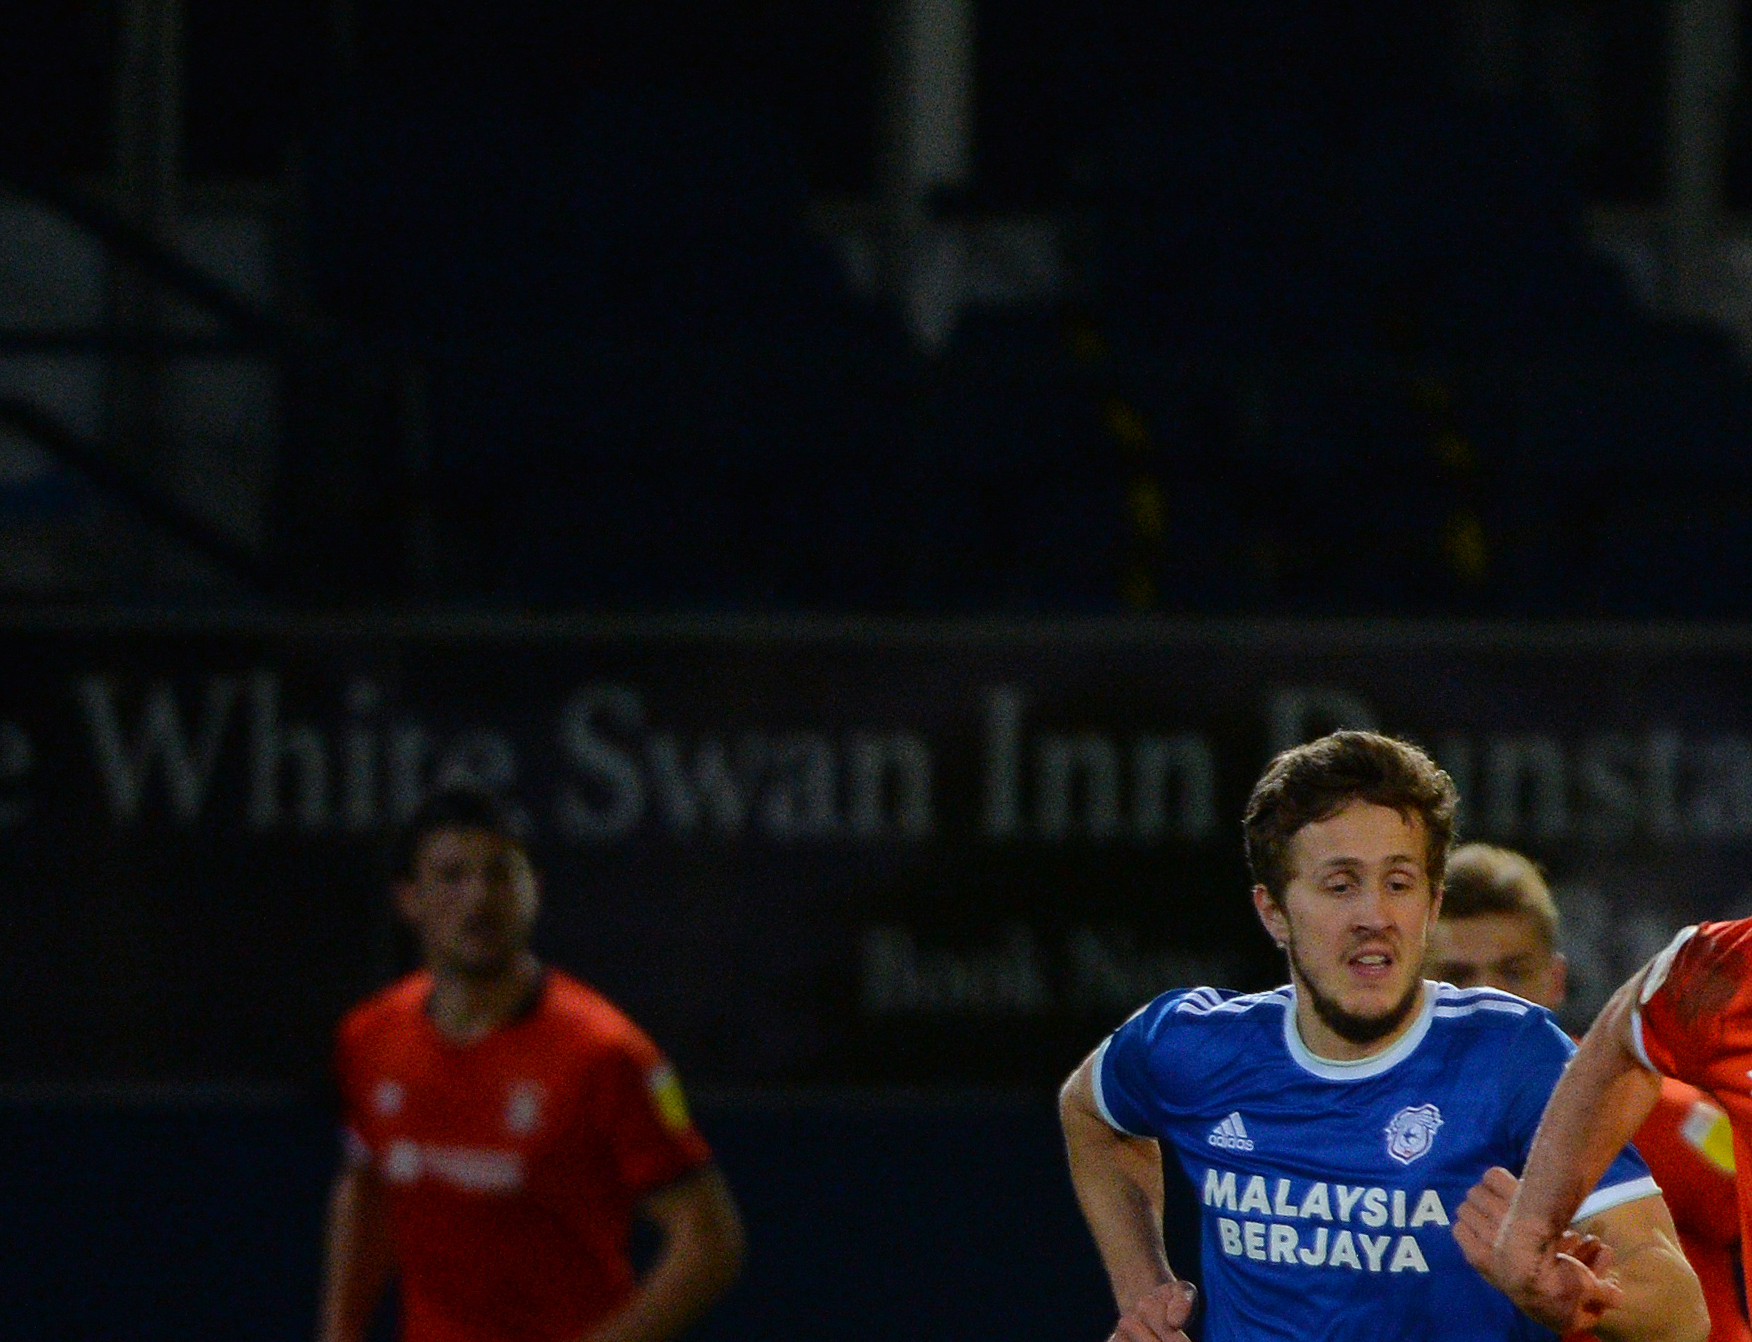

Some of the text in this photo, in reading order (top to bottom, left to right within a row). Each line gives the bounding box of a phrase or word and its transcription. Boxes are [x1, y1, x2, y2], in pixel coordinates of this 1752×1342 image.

[555, 680, 935, 838] Swan
[980, 682, 1218, 838] Inn
[1208, 1133, 1254, 1151] adidas
[1203, 1168, 1450, 1228] MALAYSIA
[1217, 1217, 1430, 1273] BERJAYA
